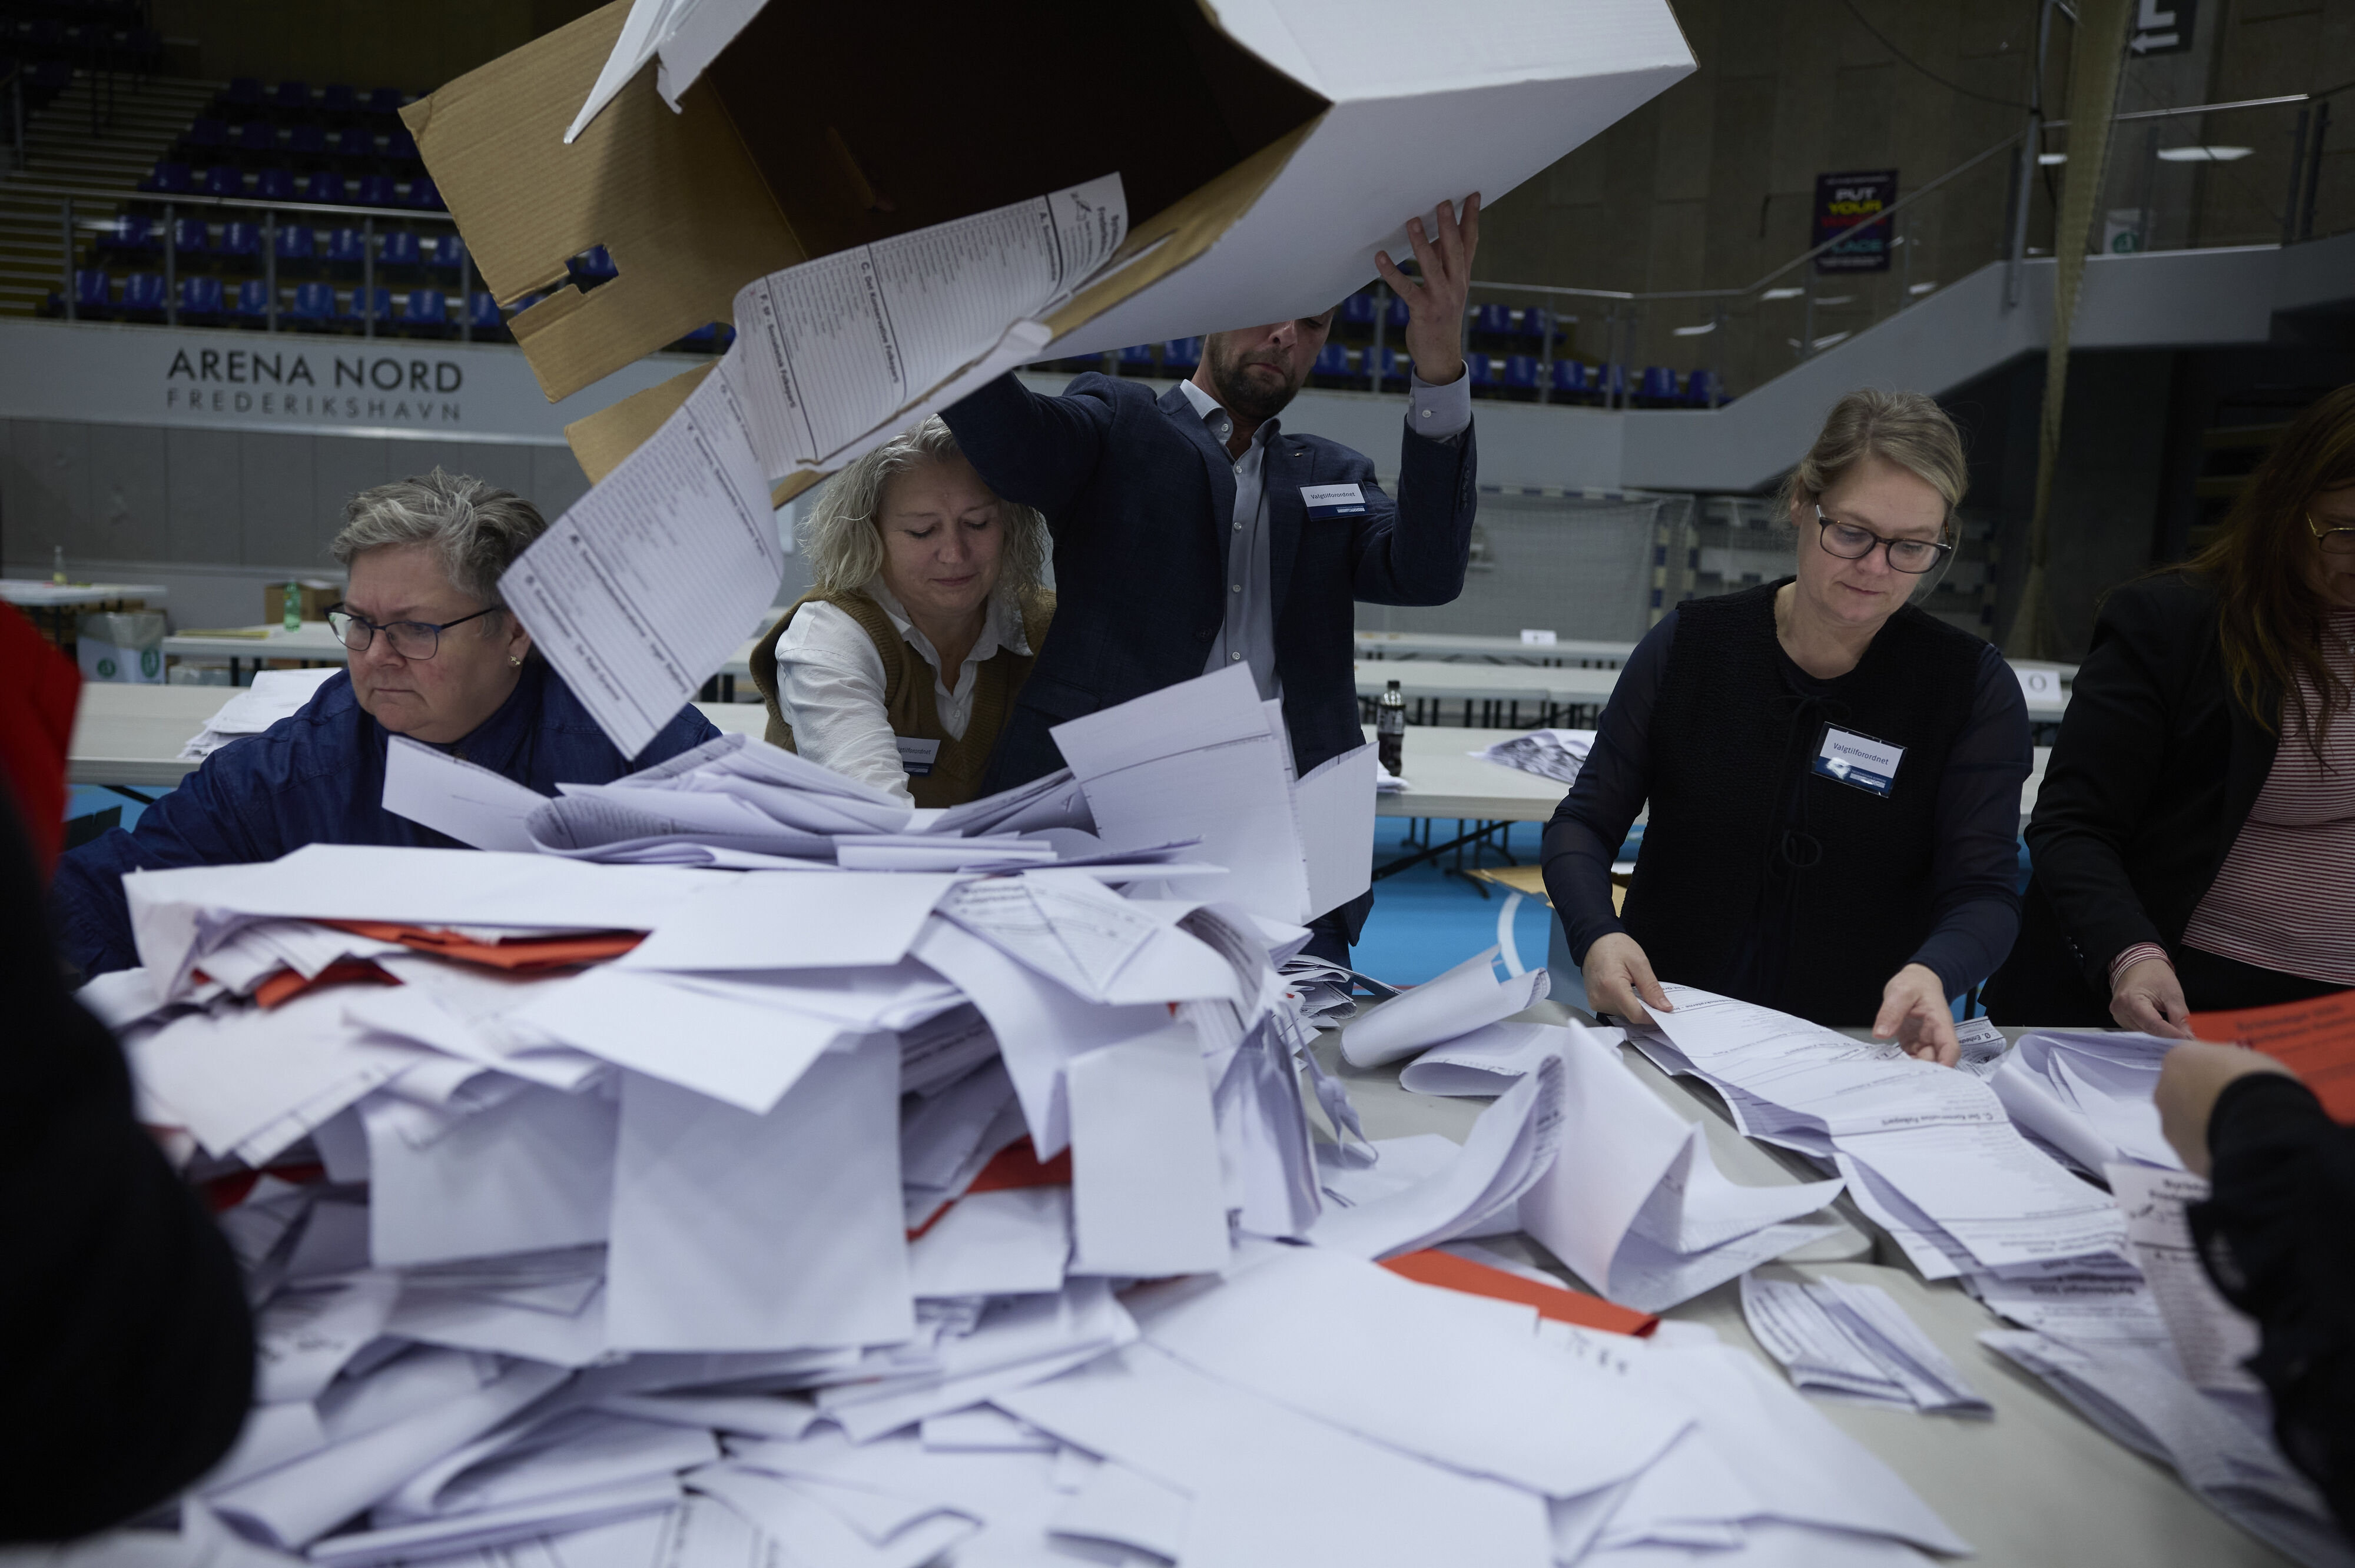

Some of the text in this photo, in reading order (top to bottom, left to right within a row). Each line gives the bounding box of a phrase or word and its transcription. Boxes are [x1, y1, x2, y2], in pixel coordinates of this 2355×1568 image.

[859, 261, 871, 274] C.
[868, 291, 889, 344] Konservative
[167, 348, 463, 394] ARENA NORD
[167, 388, 460, 421] FREDERIKSHAVN
[1311, 491, 1356, 500] Valgtilforordnet
[897, 746, 931, 755] lgtilforordnet
[1833, 742, 1889, 765] Valgtilforordnet
[1958, 1035, 1981, 1044] Enheds
